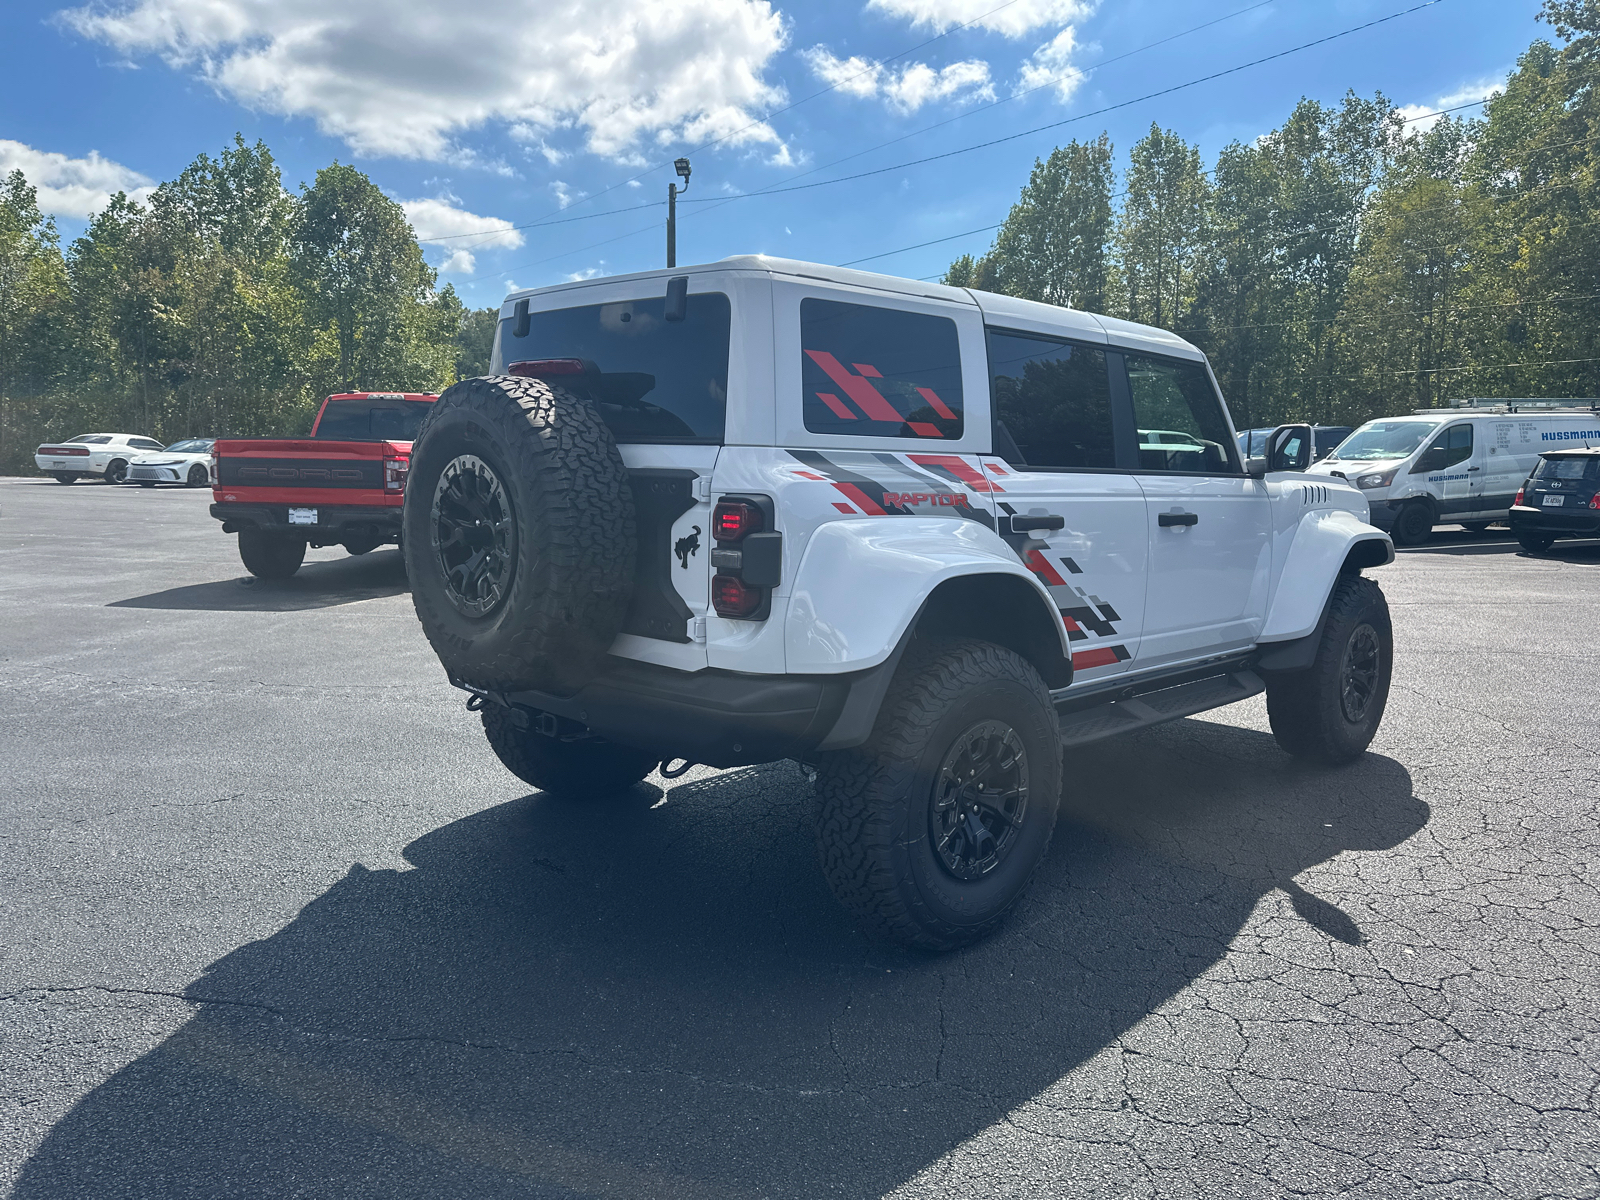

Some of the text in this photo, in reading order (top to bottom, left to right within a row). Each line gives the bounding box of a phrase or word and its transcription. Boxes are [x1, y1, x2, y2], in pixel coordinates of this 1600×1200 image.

[1541, 430, 1600, 441] HUSSMANN
[237, 467, 363, 481] FORD
[1428, 474, 1469, 482] HUSSMANN
[882, 492, 972, 513] RAPTOR
